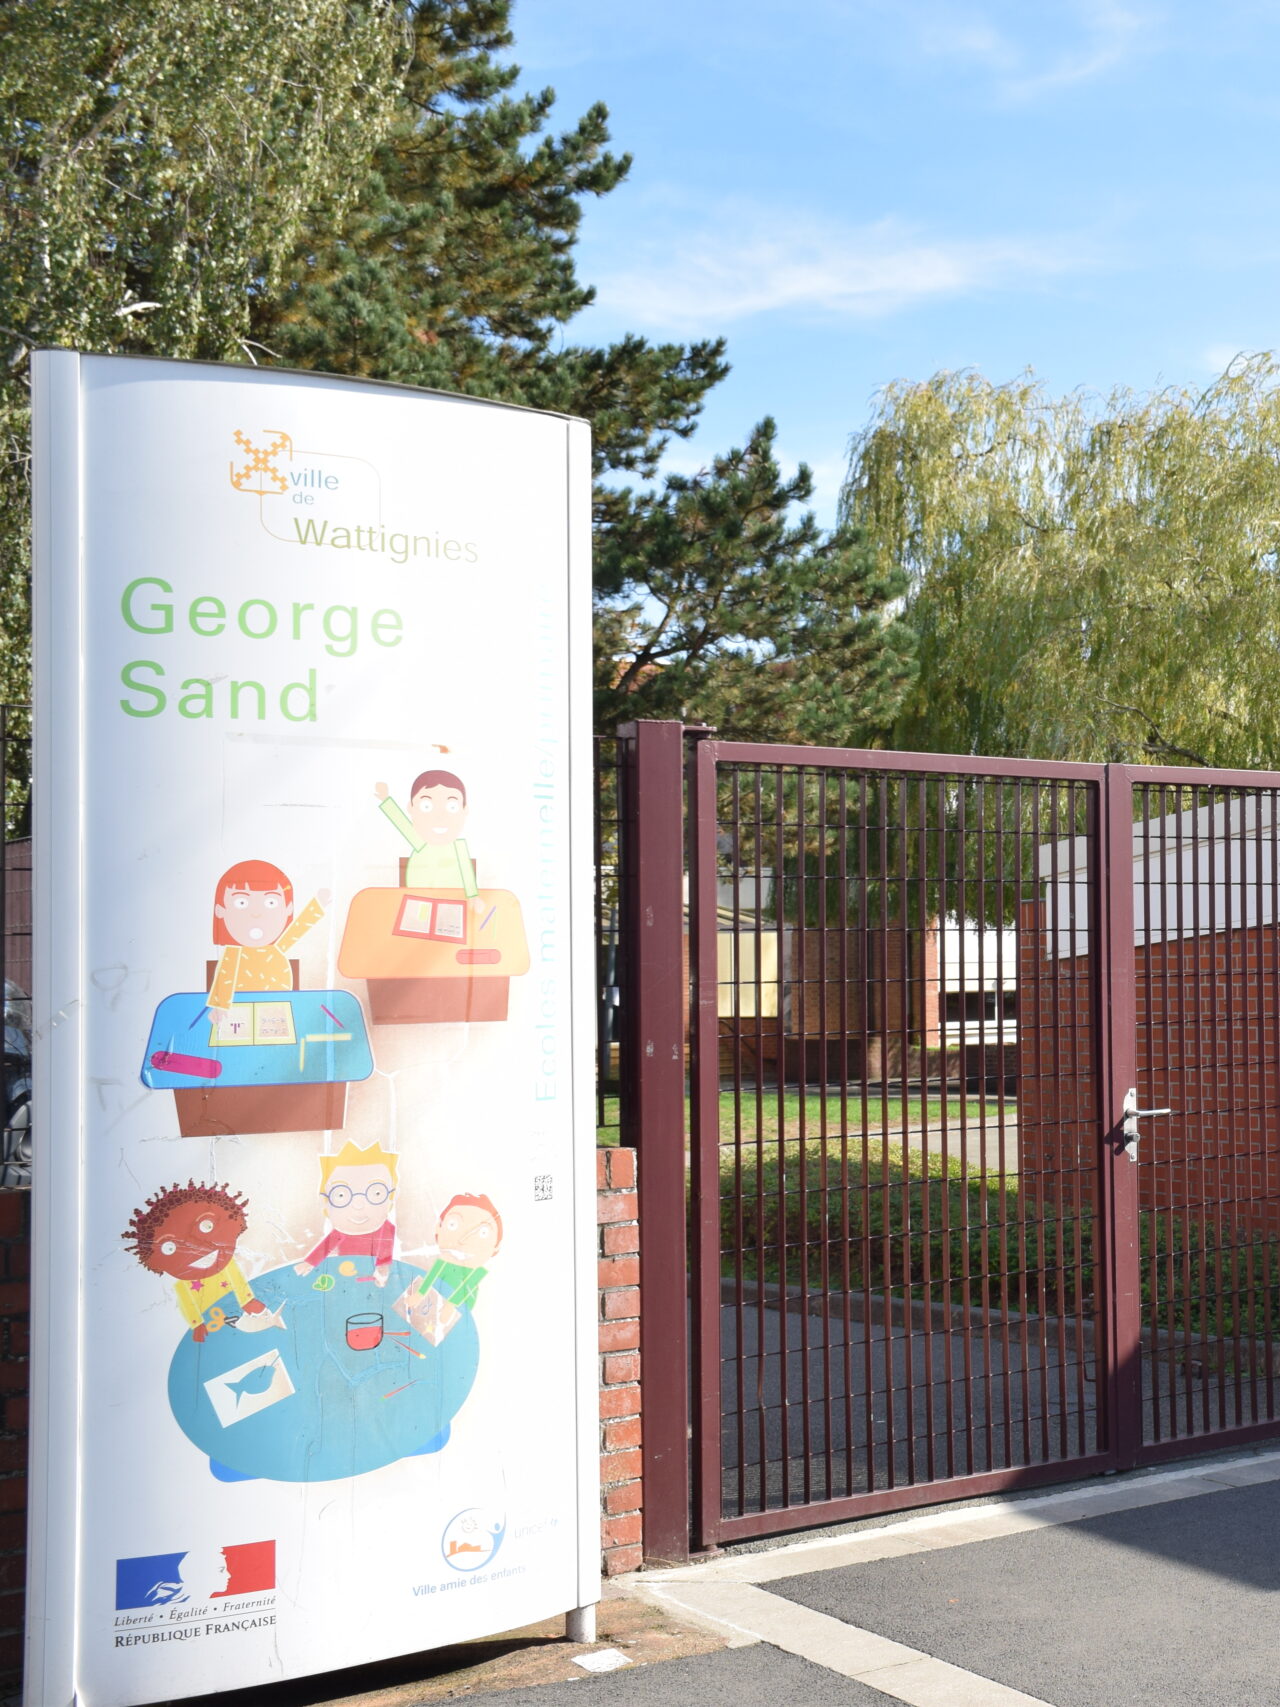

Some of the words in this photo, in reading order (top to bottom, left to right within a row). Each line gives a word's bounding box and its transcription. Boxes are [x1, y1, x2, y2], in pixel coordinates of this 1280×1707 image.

[289, 468, 339, 490] ville
[292, 491, 315, 505] de
[293, 517, 479, 564] Wattignies
[120, 577, 403, 658] George
[120, 660, 318, 723] Sand
[412, 1584, 437, 1597] Ville
[439, 1578, 467, 1592] amie
[469, 1575, 488, 1585] des
[490, 1565, 526, 1581] enfants
[114, 1614, 154, 1627] Liberté
[169, 1607, 208, 1620] Égalité
[223, 1596, 277, 1612] Fraternité
[114, 1627, 201, 1648] RÉPUBLIQUE
[205, 1615, 277, 1635] FRANÇAISE
